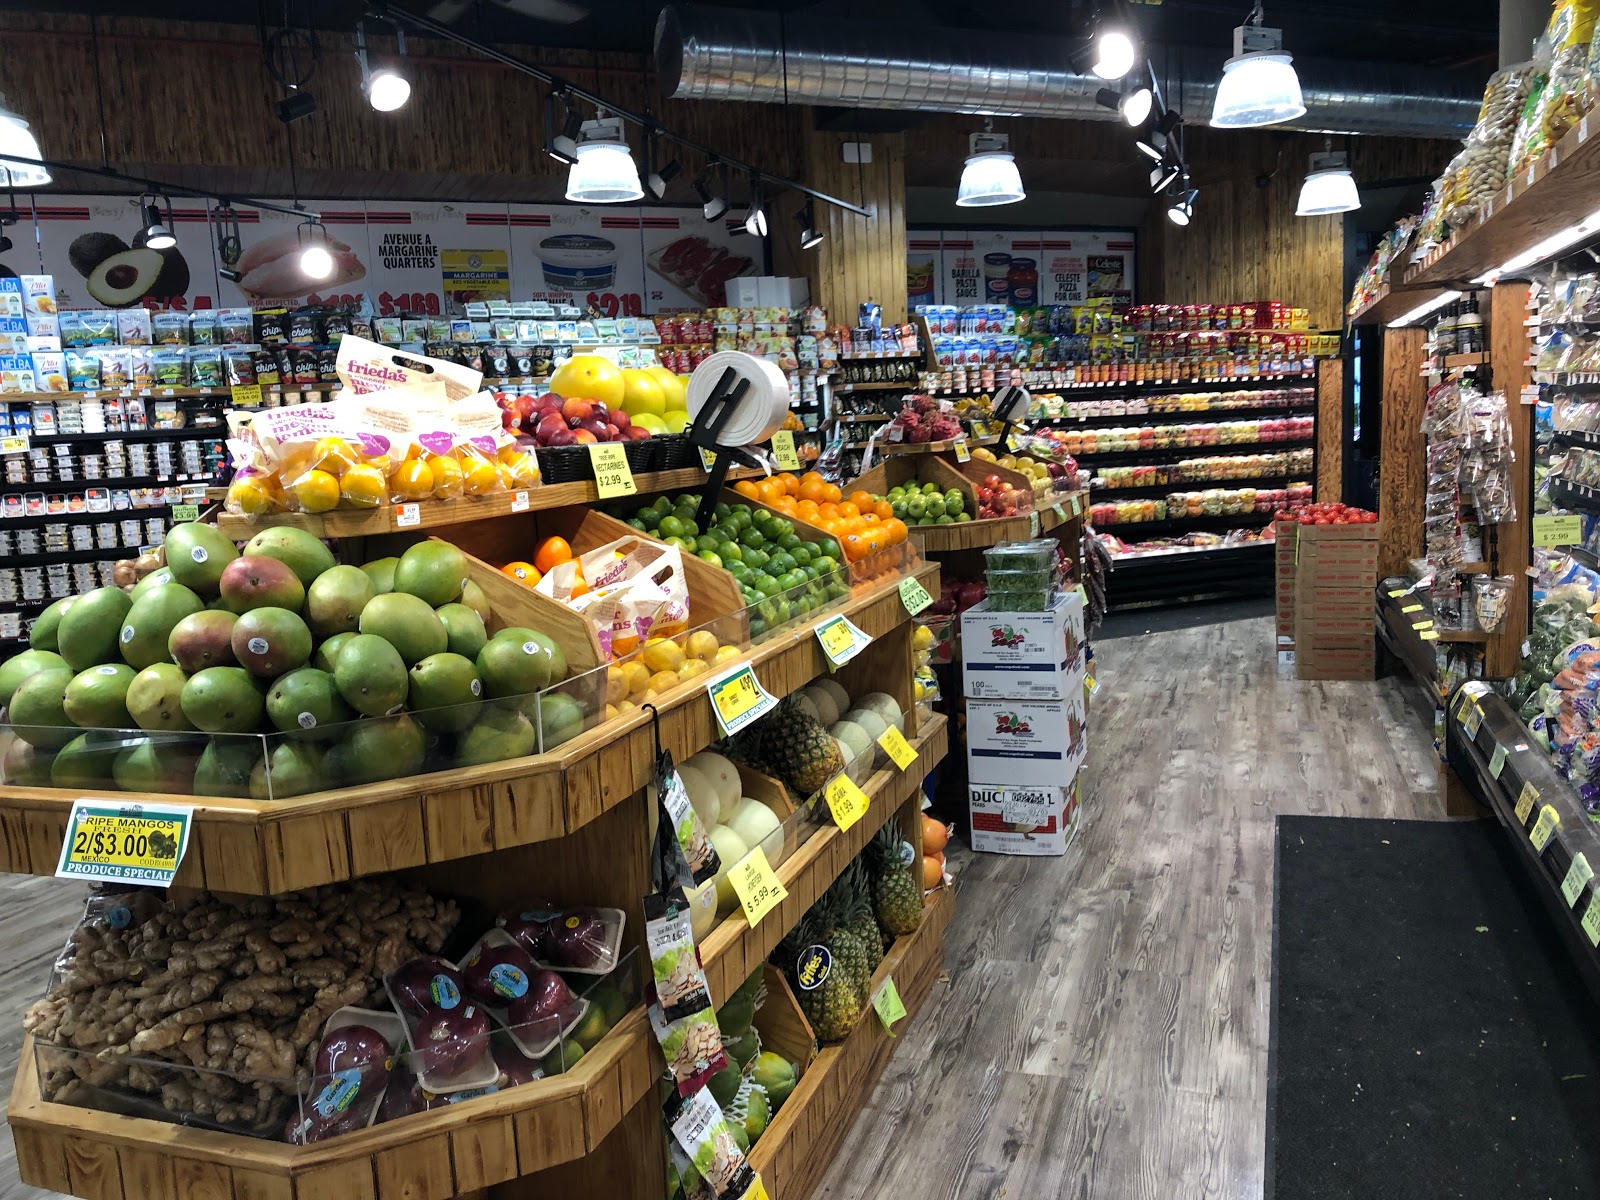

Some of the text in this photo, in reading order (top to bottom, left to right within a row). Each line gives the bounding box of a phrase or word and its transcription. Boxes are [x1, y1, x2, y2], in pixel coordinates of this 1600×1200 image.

[383, 234, 432, 245] AVENUE A
[378, 246, 438, 257] MARGARINE
[383, 257, 435, 270] QUARTERS
[952, 269, 980, 278] BARILLA
[1055, 273, 1081, 283] CELESTE
[0, 281, 18, 293] LBA
[956, 279, 977, 288] PASTA
[1058, 283, 1077, 292] PIZZA
[956, 288, 978, 298] SAUCE
[1054, 292, 1082, 301] FOR ONE
[428, 347, 455, 357] bare
[463, 347, 484, 357] bar
[487, 348, 506, 357] bar
[535, 348, 551, 357] are
[1, 358, 31, 370] MELBA
[347, 360, 408, 382] frieda's
[595, 461, 625, 472] NECTARINES
[605, 474, 621, 485] 2.99
[595, 559, 628, 587] frieda's
[971, 791, 1005, 804] DUC
[839, 799, 854, 815] 1.99
[86, 817, 174, 829] RIPE MANGOS
[93, 826, 142, 834] FRESH
[74, 831, 148, 857] 2/$3.00
[80, 855, 110, 863] MEXICO
[66, 862, 176, 881] PRODUCE SPECIALS
[753, 886, 768, 906] 5.99
[502, 969, 520, 985] Garden
[493, 981, 514, 998] ORGANIC
[325, 1079, 347, 1101] Garden
[337, 1085, 359, 1111] ORGANIC
